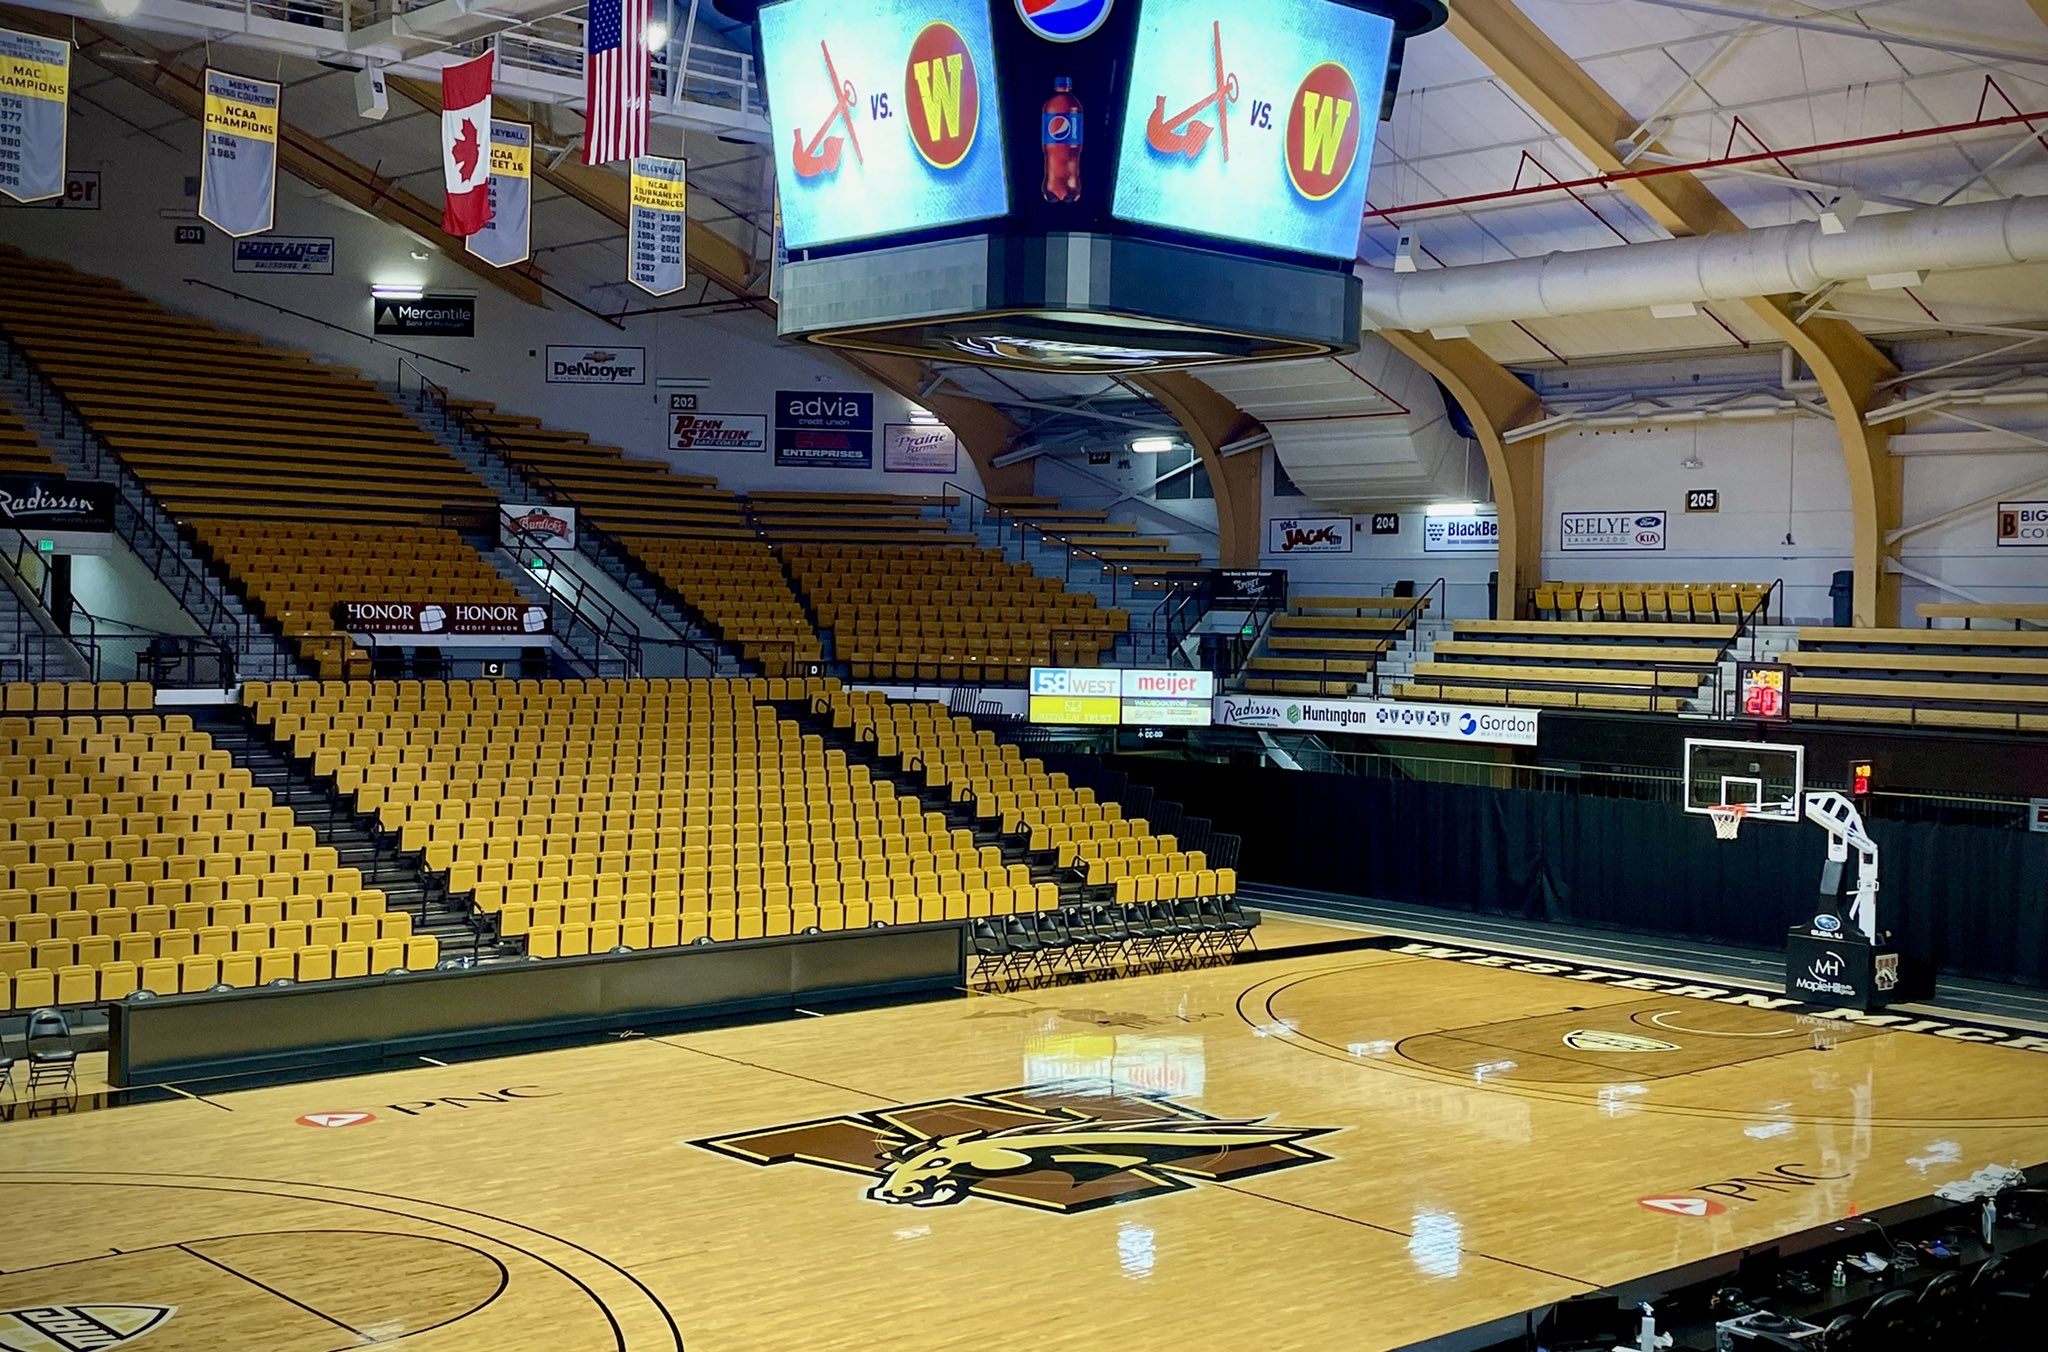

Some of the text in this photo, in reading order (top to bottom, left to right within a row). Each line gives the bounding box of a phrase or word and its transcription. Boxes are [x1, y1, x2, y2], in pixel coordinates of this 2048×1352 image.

[13, 65, 41, 78] MAC
[228, 80, 258, 93] MEN'S
[209, 84, 275, 105] CROSS COUNTRY
[913, 53, 963, 142] W
[0, 97, 22, 109] 976
[870, 92, 893, 120] VS.
[0, 110, 22, 122] 977
[225, 105, 257, 120] NCAA
[1250, 99, 1272, 130] VS.
[206, 113, 273, 135] CHAMPIONS
[491, 129, 525, 140] LEYBALL
[1302, 90, 1352, 176] W
[490, 159, 524, 171] EET 16
[635, 186, 683, 200] TOURNAMENT
[648, 181, 668, 190] NCAA
[634, 194, 684, 208] APPEARANCES
[399, 305, 471, 320] Mercantile
[554, 362, 636, 381] DeNooyer
[673, 397, 694, 408] 202
[789, 396, 859, 417] advia
[673, 415, 724, 434] PENN
[677, 429, 750, 448] STATION
[895, 432, 946, 447] Prairie
[783, 448, 864, 458] ENTERPRISES
[0, 486, 94, 518] Radisson
[1690, 493, 1714, 507] 205
[1376, 517, 1395, 529] 204
[1448, 521, 1499, 536] BlackBe
[1564, 517, 1657, 535] SEELYE Ford
[1281, 525, 1336, 551] JACK
[1640, 535, 1656, 543] KIA
[2021, 528, 2048, 538] CO
[348, 604, 415, 620] HONOR
[456, 606, 518, 621] HONOR
[490, 664, 498, 673] C
[811, 666, 818, 674] D
[1072, 680, 1116, 693] WEST
[1138, 673, 1197, 695] meijer
[1746, 687, 1777, 716] 20
[1224, 698, 1280, 723] Radisson
[1303, 705, 1366, 726] Huntington
[1480, 714, 1535, 733] Gordon
[1815, 959, 1839, 976] MH
[1389, 943, 1804, 1009] WESTERN
[386, 1085, 563, 1116] PNC
[1689, 1163, 1851, 1202] PNC
